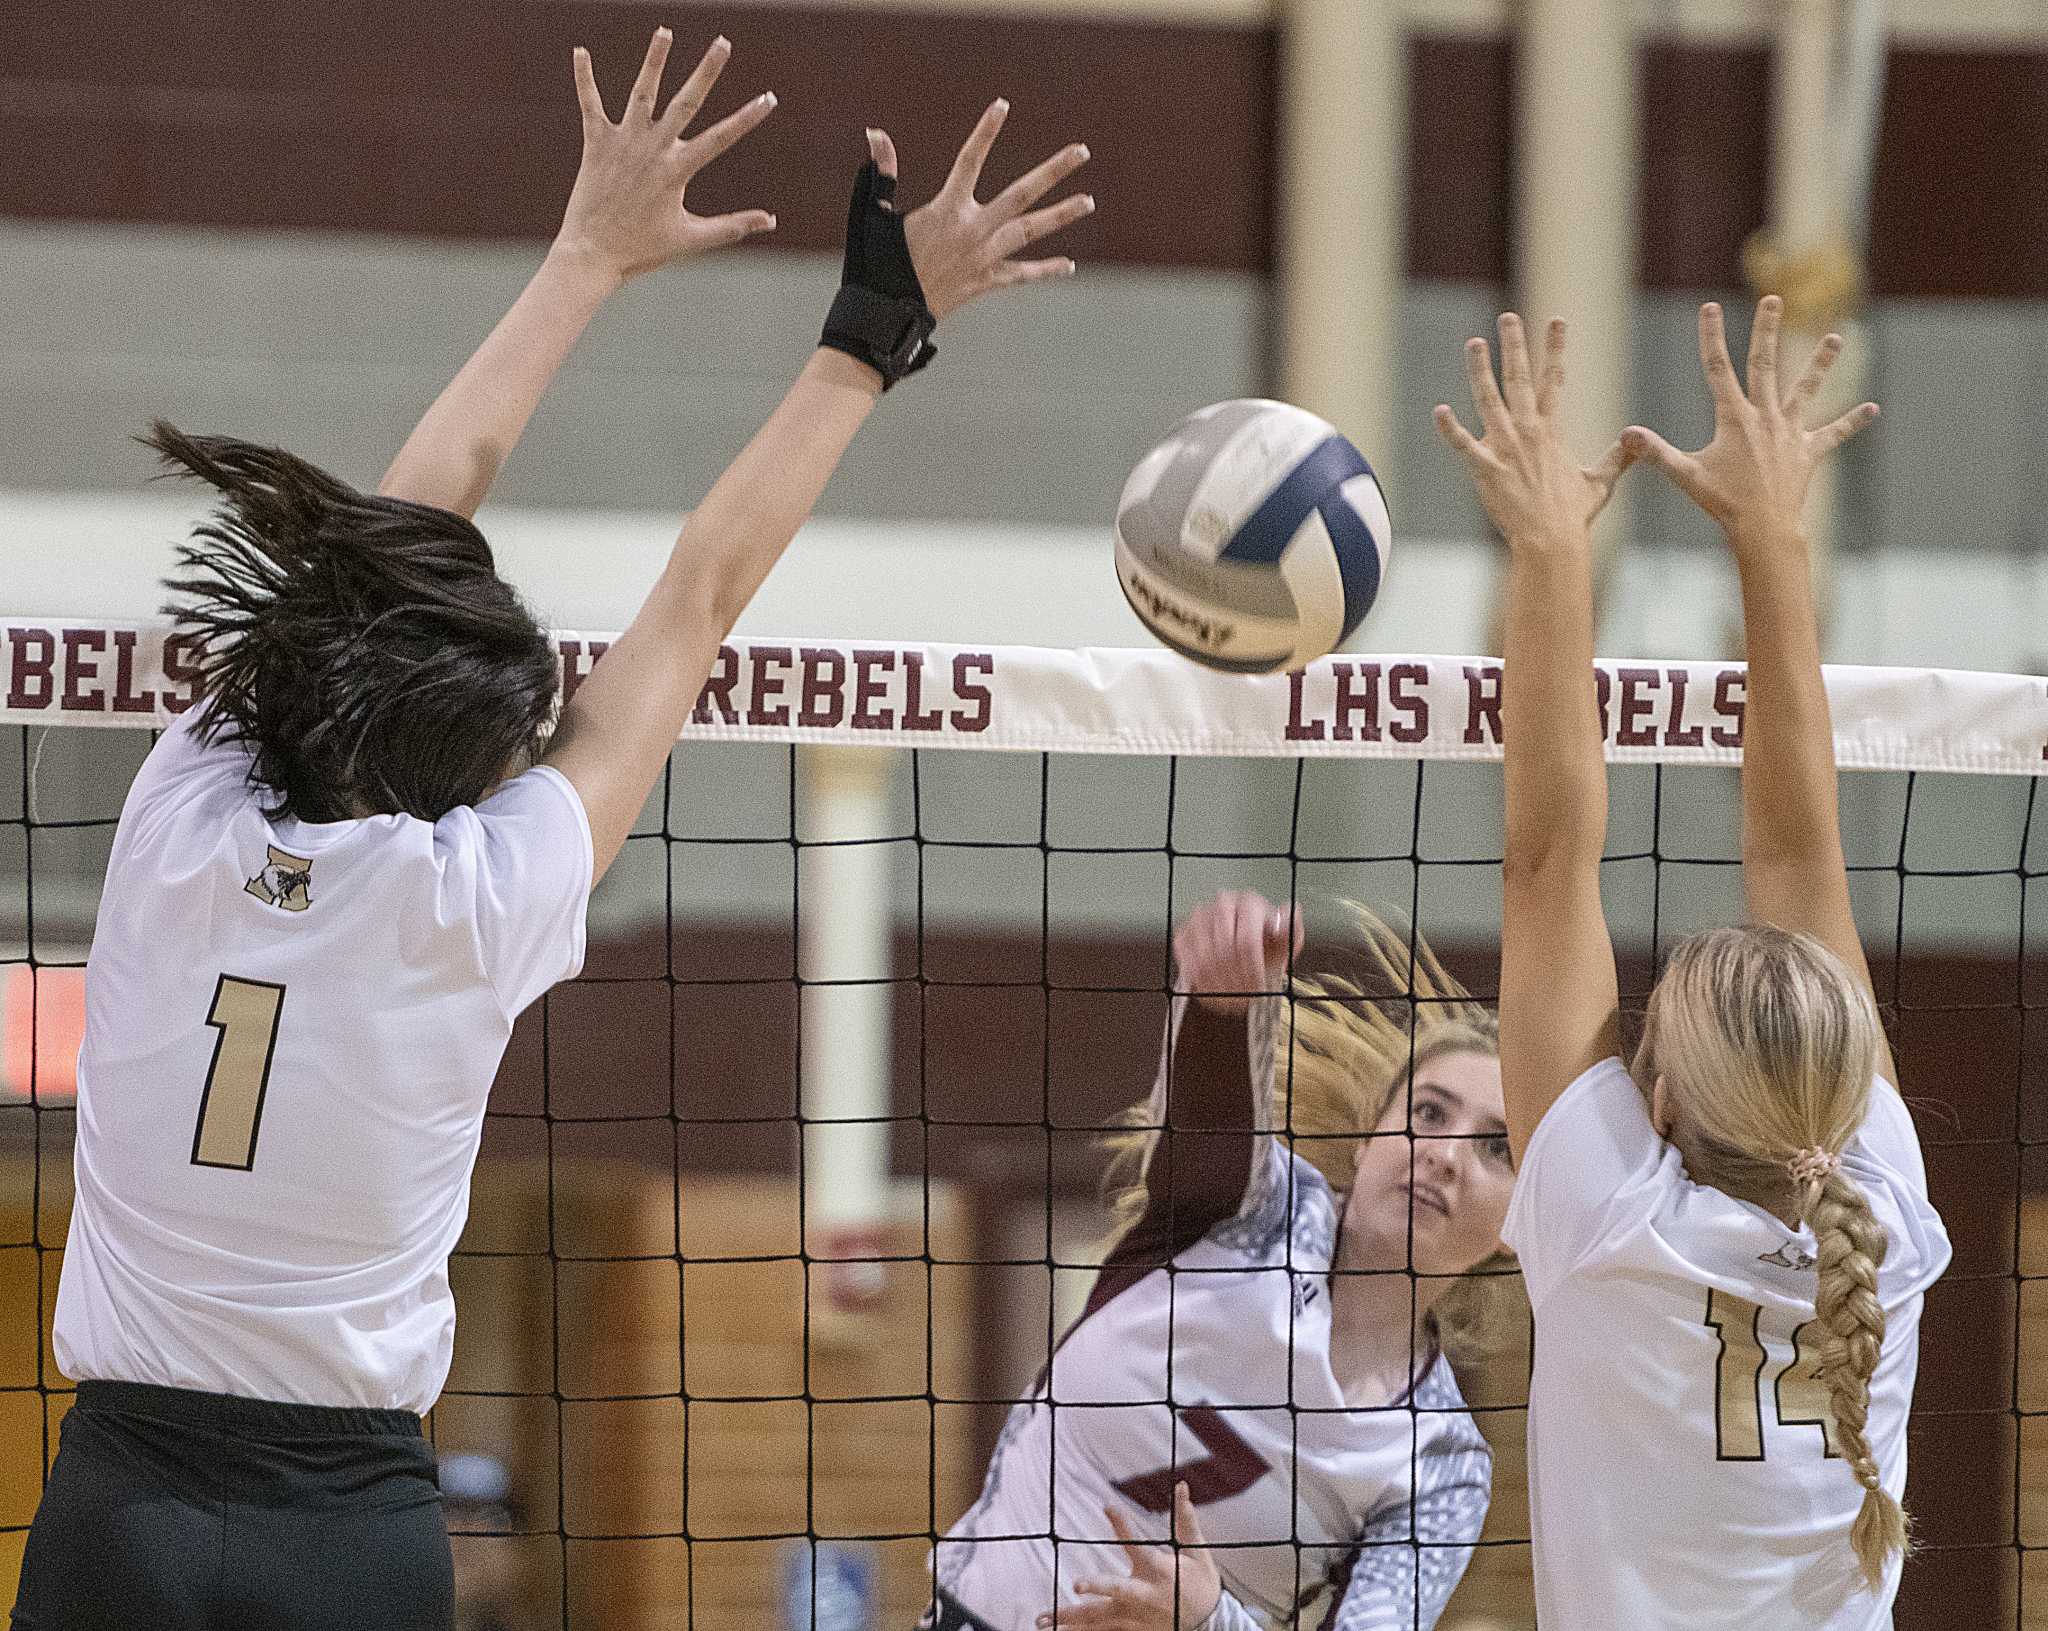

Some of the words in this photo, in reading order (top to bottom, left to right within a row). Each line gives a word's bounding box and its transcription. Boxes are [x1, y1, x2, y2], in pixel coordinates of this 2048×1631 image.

[1, 627, 204, 714] BELS
[692, 643, 994, 732] REBELS
[1286, 662, 1430, 743] LHS
[1463, 666, 1747, 748] RELS
[190, 972, 286, 1172] 1
